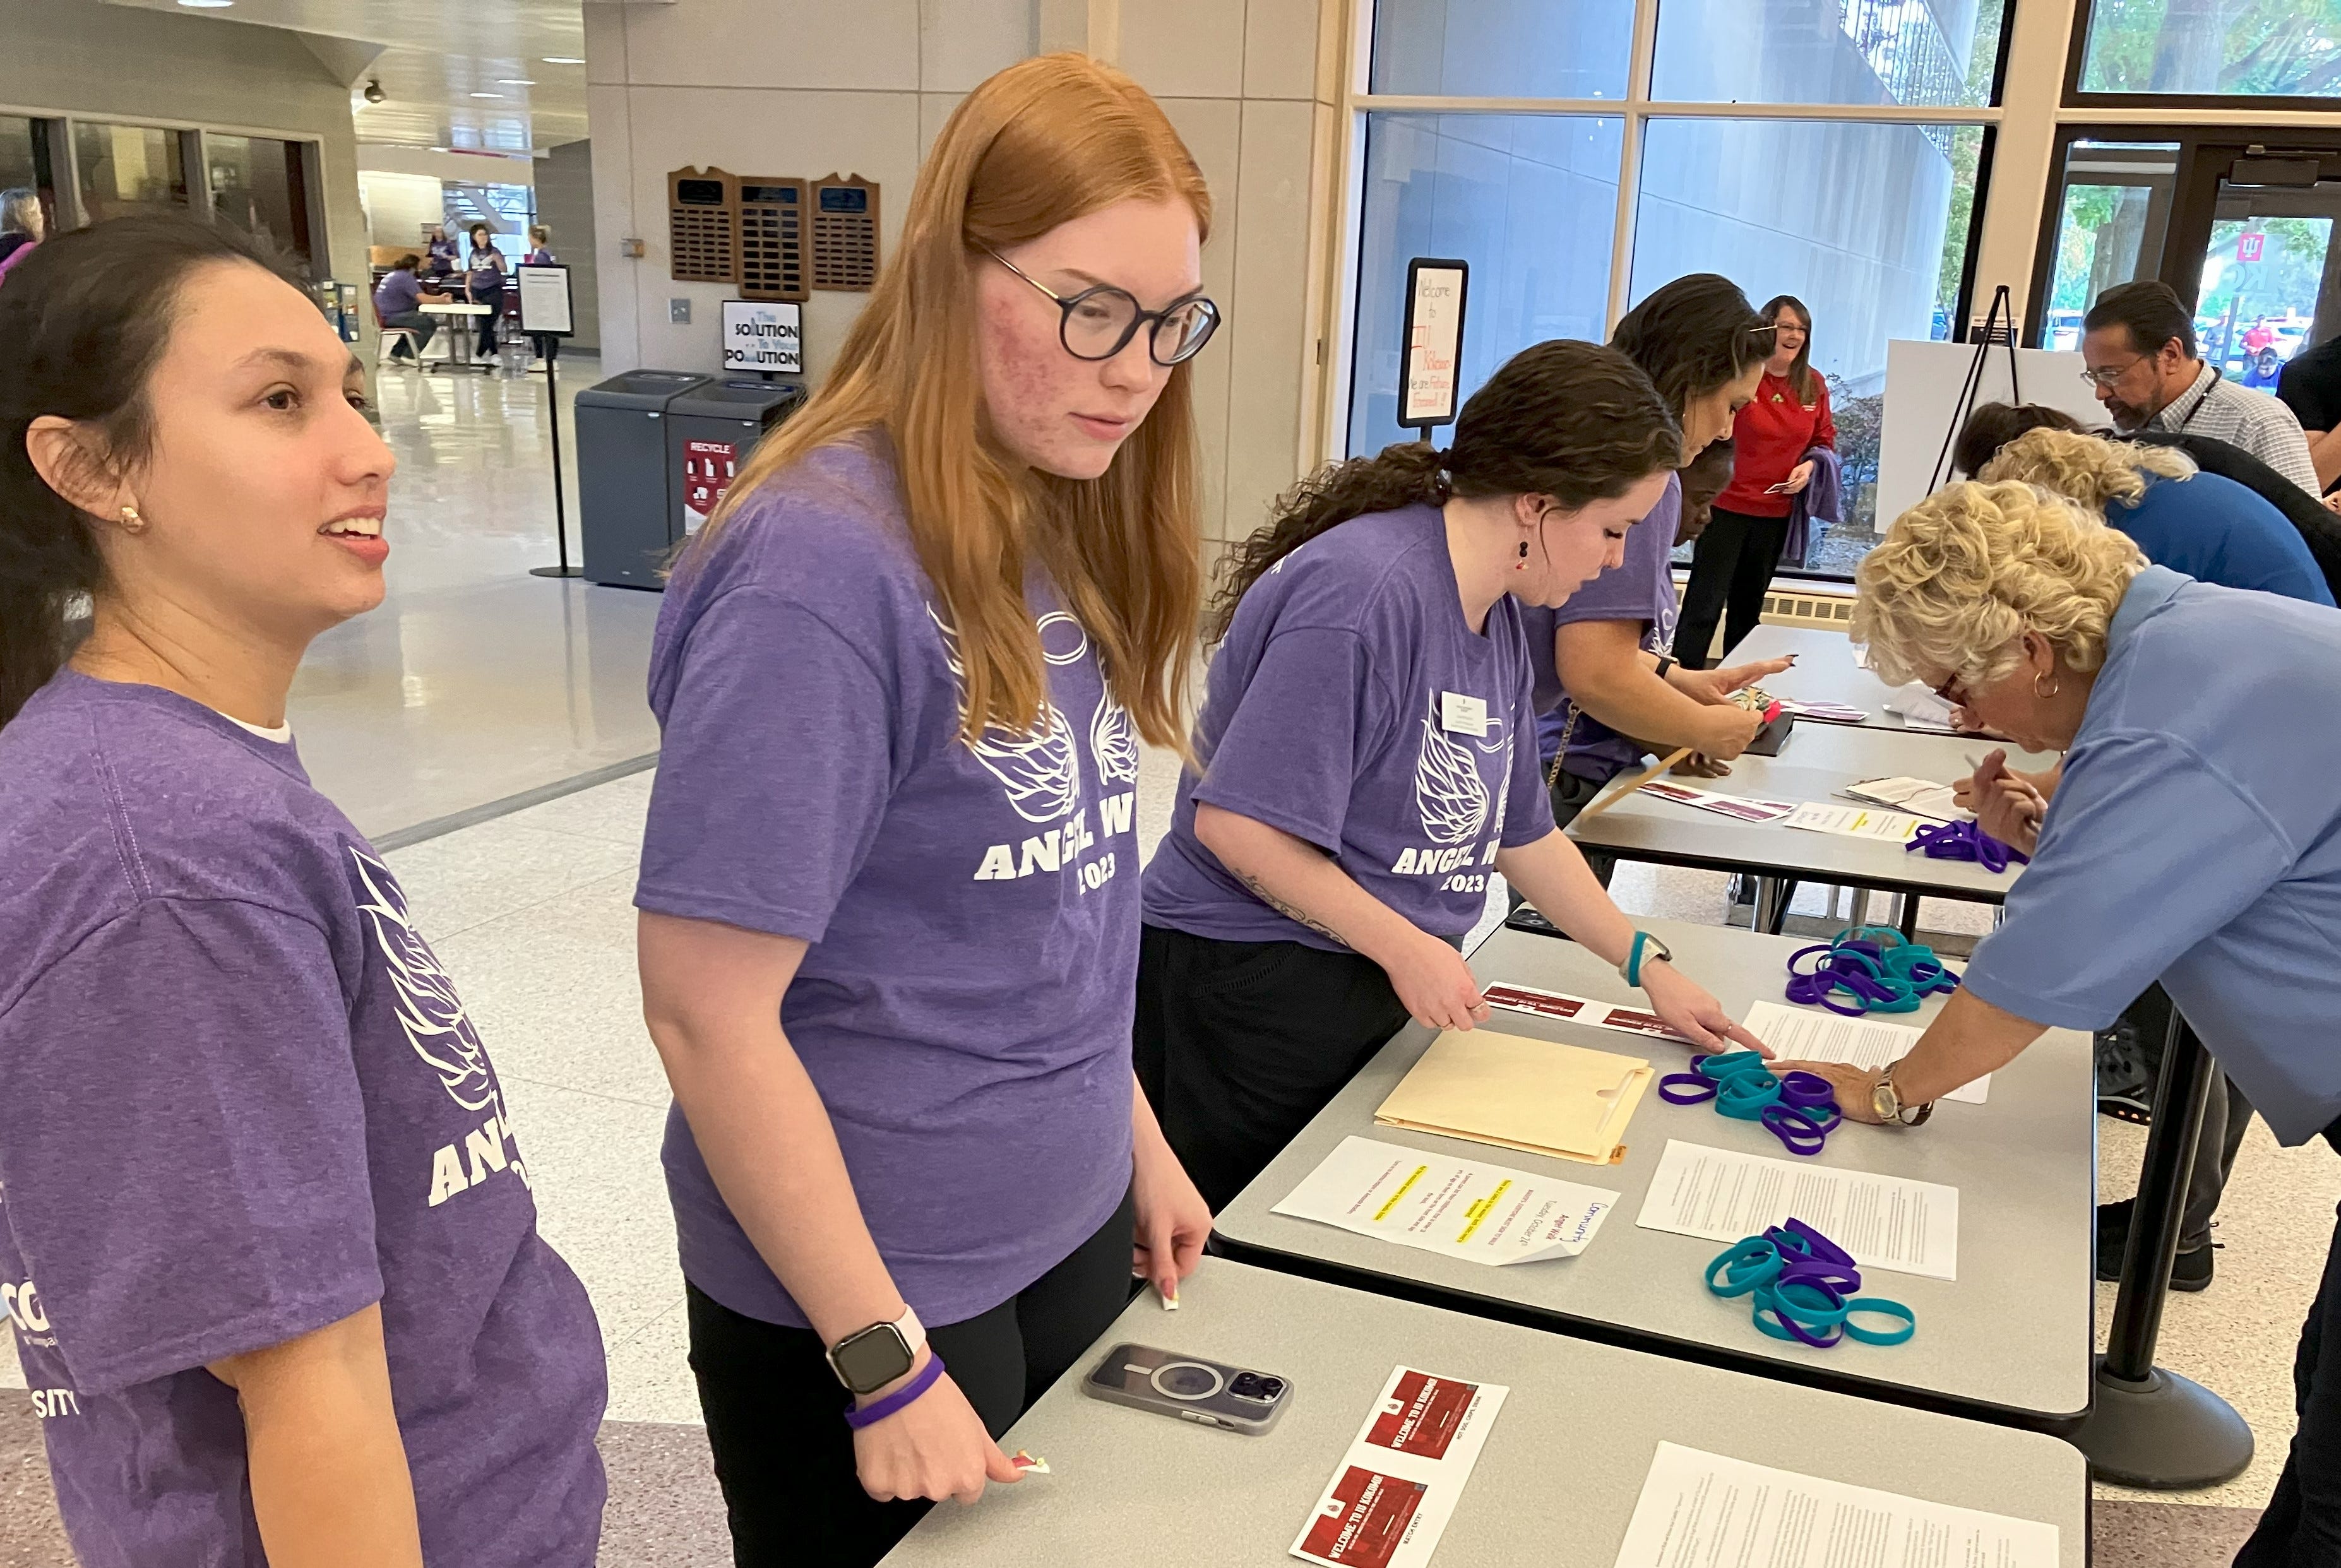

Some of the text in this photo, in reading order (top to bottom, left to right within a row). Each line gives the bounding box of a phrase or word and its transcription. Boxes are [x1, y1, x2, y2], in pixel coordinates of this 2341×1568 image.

[1416, 278, 1450, 298] Welcome
[1429, 302, 1436, 318] to
[691, 442, 730, 454] RECYCLE
[1391, 842, 1477, 875] ANGEL
[1078, 852, 1115, 896] 2023
[1439, 874, 1484, 893] 2023
[1524, 1218, 1543, 1237] October
[1546, 1214, 1570, 1240] Angel Walk
[1559, 1202, 1609, 1243] Community
[1408, 1409, 1421, 1418] TO
[1412, 1402, 1424, 1411] IU
[1391, 1418, 1415, 1448] WELCOME
[1350, 1512, 1362, 1523] TO
[1354, 1504, 1367, 1513] IU
[1328, 1522, 1357, 1559] WELCOME
